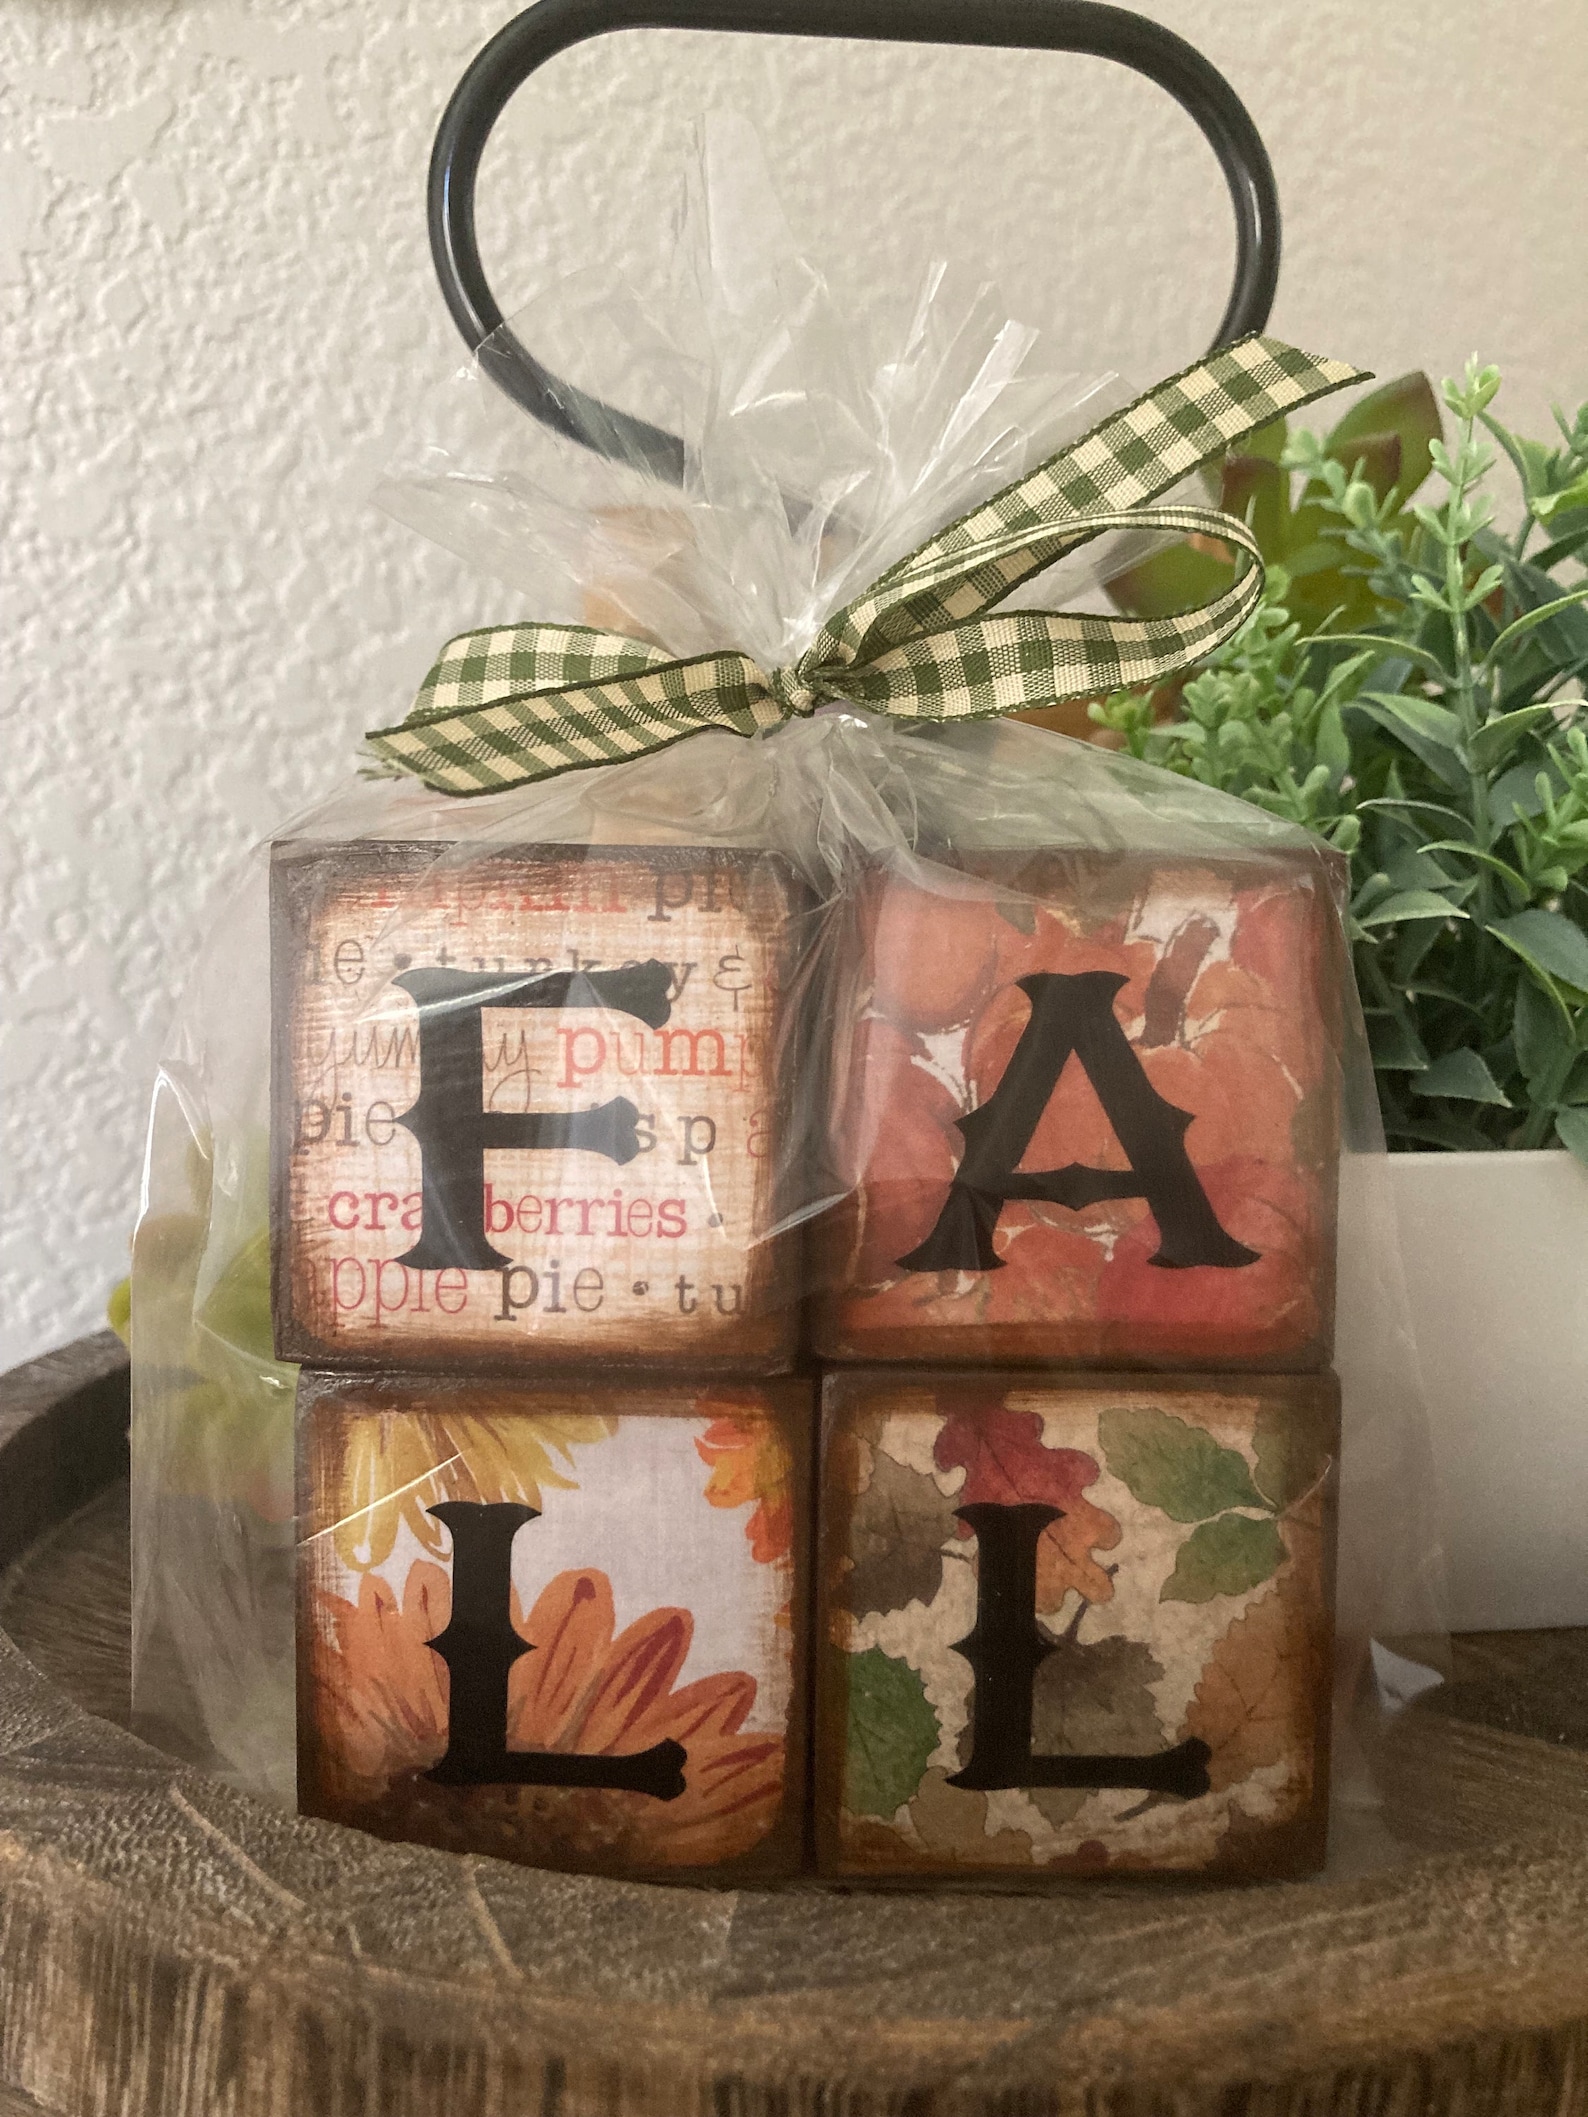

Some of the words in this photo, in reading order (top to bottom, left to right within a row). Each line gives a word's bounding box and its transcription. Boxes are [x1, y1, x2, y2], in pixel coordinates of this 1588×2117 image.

[328, 1181, 689, 1240] craberries
[391, 958, 672, 1271] F
[895, 970, 1262, 1271] A
[493, 1258, 605, 1321] pie
[424, 1502, 688, 1792] L
[946, 1502, 1212, 1795] L
